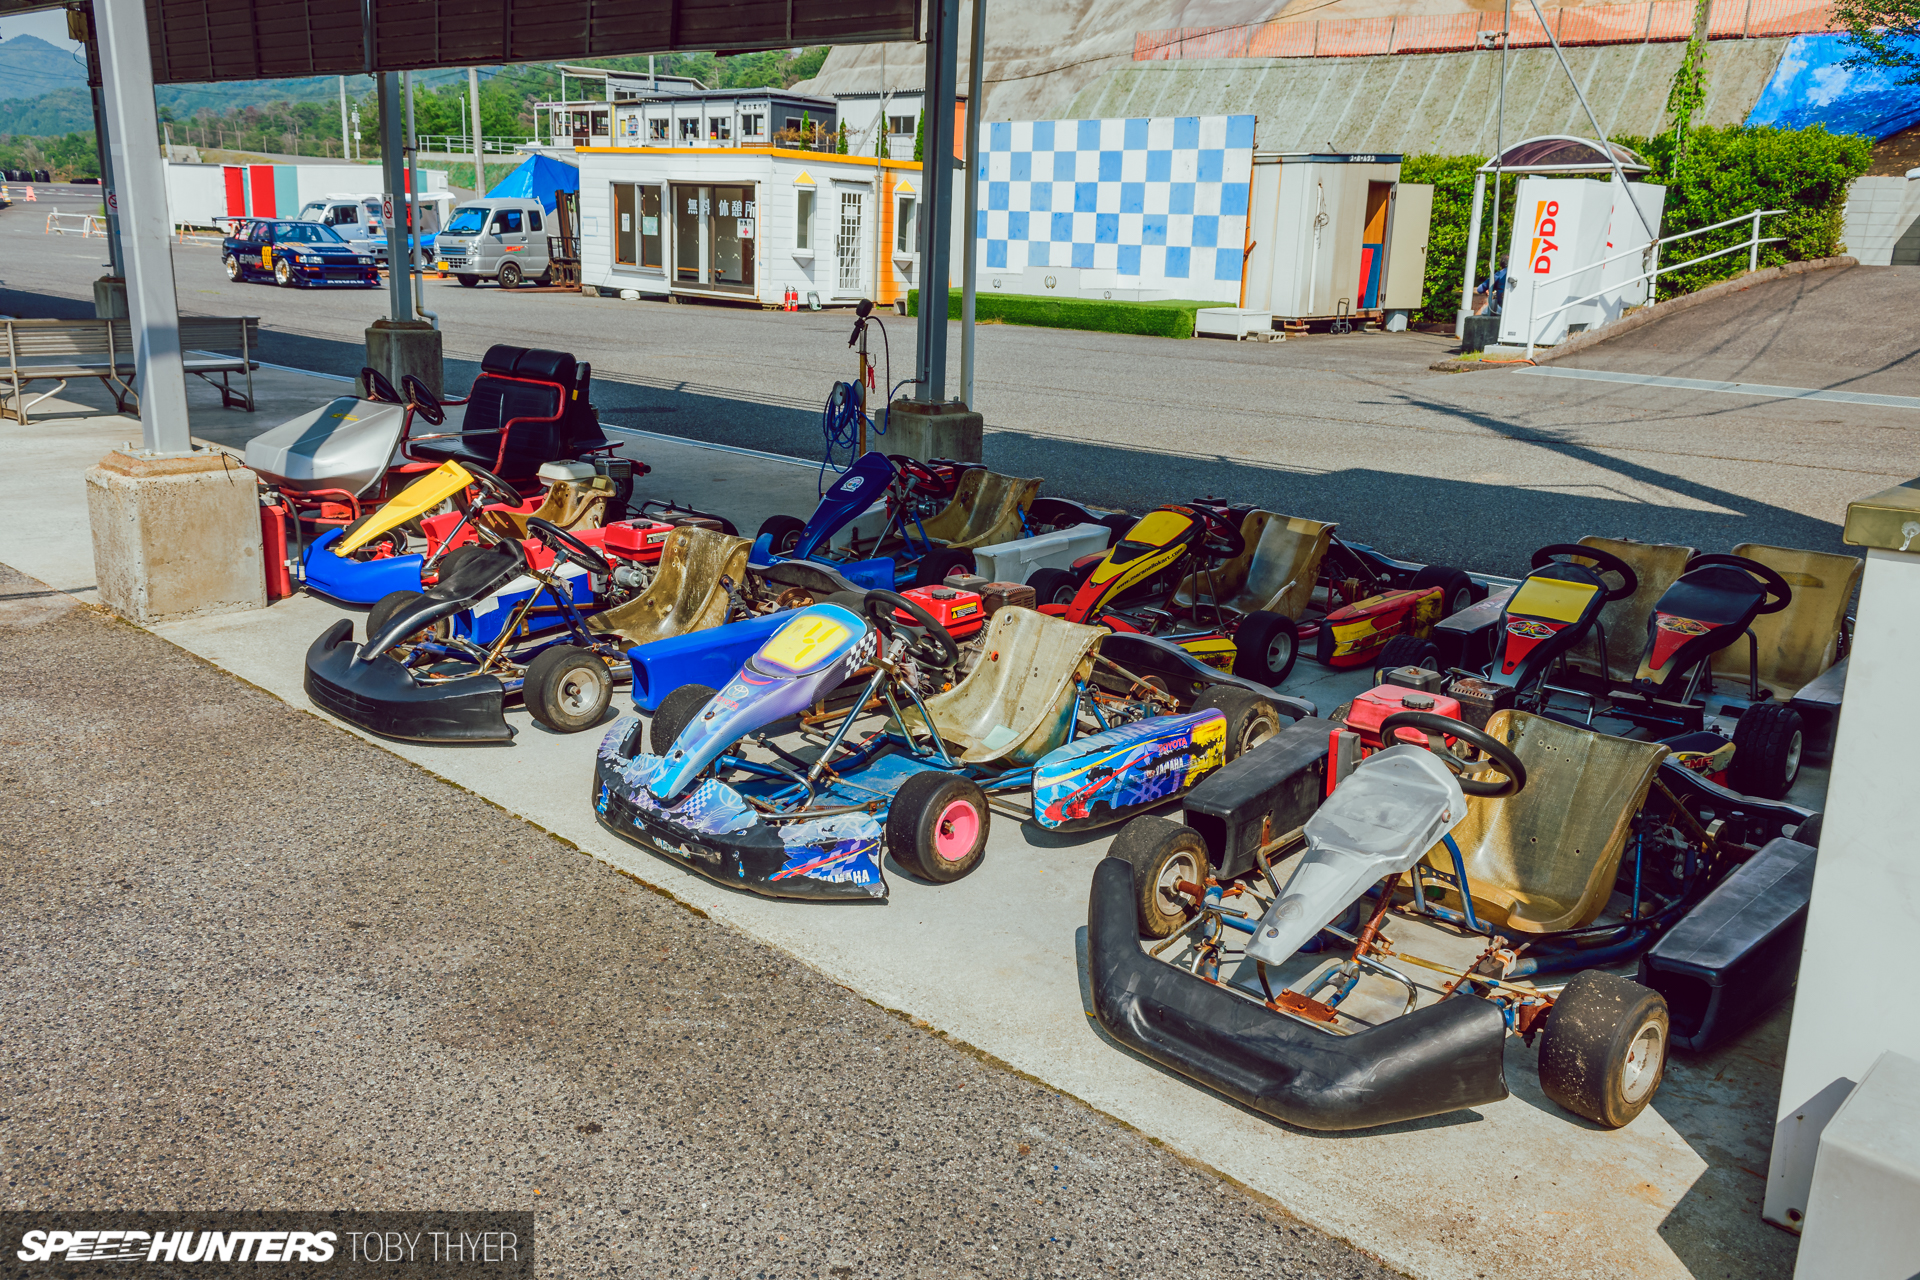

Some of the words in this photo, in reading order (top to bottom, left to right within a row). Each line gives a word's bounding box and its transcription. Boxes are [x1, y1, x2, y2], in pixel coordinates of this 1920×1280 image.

[1534, 200, 1559, 274] DyDo
[714, 695, 740, 710] TOYOTA
[1158, 737, 1188, 753] TOYOTA
